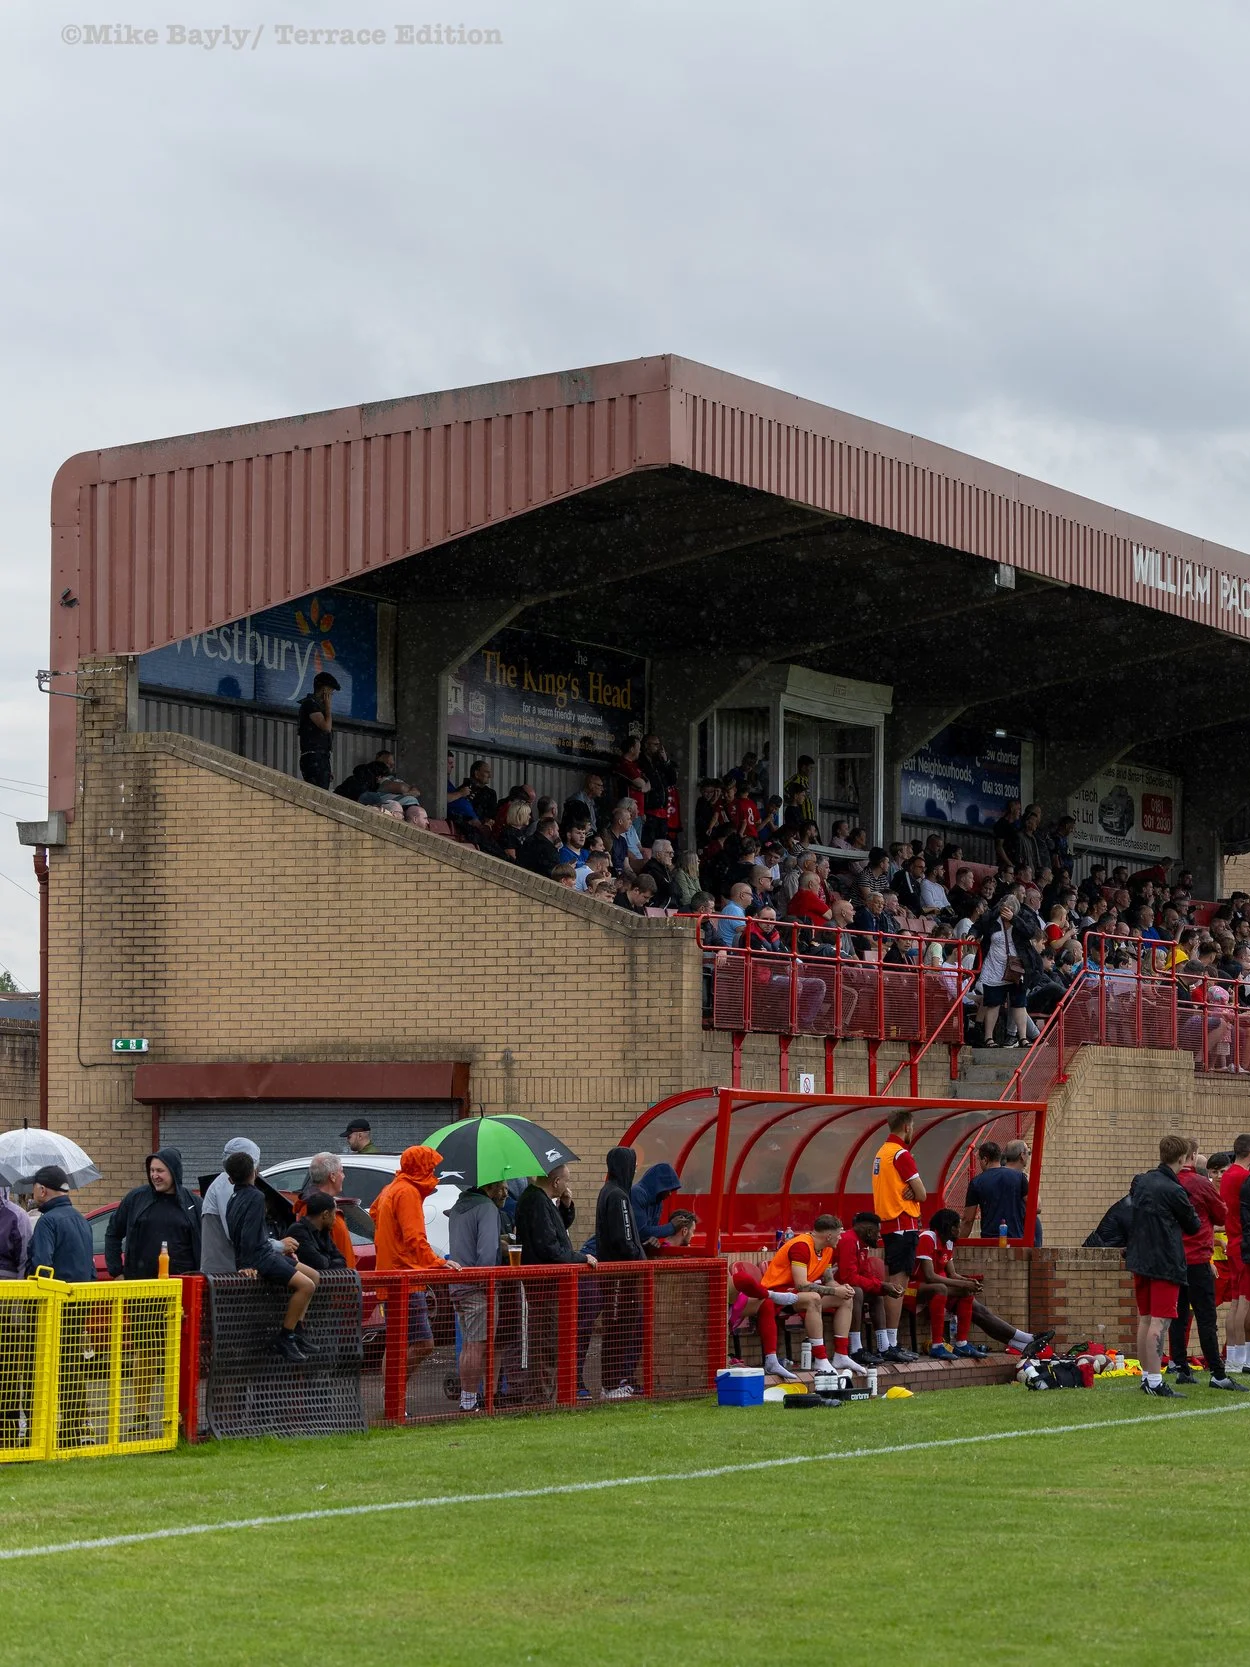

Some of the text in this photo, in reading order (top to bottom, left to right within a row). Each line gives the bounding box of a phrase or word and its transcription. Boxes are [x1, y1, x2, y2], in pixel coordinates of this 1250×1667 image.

[1132, 545, 1211, 605] WILLIAM
[574, 649, 589, 666] he
[481, 650, 633, 711] The King's Head
[522, 701, 603, 727] for a warm friendly welcome!
[996, 748, 1020, 766] charter
[918, 756, 975, 785] Neighbourhoods,
[909, 779, 957, 805] Great People.
[982, 780, 1019, 799] 0161 331 2000
[747, 807, 755, 825] 8
[1082, 808, 1094, 825] Ltd
